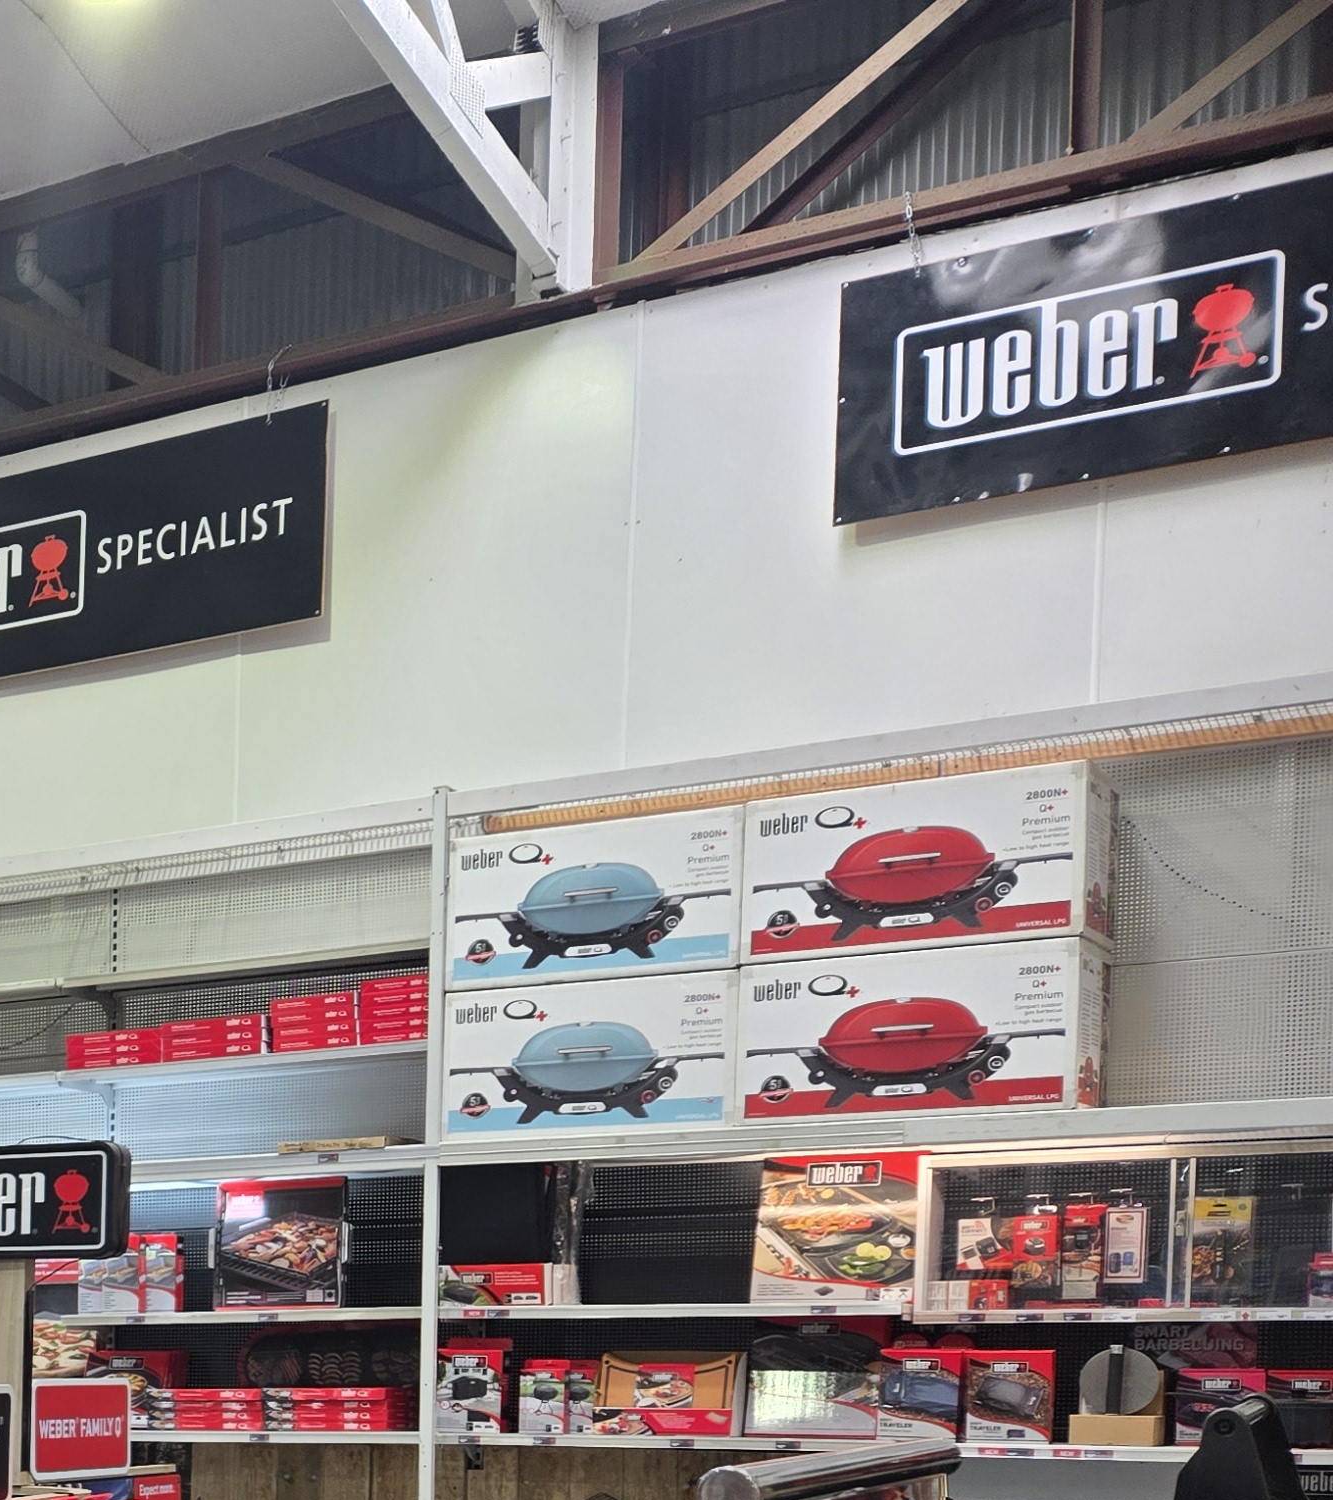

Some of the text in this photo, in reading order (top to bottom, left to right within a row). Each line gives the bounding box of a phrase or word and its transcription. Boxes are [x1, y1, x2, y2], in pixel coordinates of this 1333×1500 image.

[923, 298, 1179, 429] weber
[96, 497, 293, 574] SPECIALIST
[760, 812, 808, 837] weber
[1022, 813, 1071, 826] Premium
[461, 848, 503, 872] weber
[687, 853, 730, 865] Premium
[753, 978, 802, 1002] weber
[1014, 990, 1064, 1002] Premium
[455, 1002, 498, 1025] weber
[680, 1017, 723, 1028] Premium
[812, 1163, 862, 1185] weber
[1134, 1325, 1191, 1339] SMART
[1134, 1338, 1245, 1351] BARBECUING
[1204, 1379, 1231, 1390] weber
[38, 1418, 76, 1439] WEBER
[79, 1416, 113, 1437] FAMILY
[139, 1483, 160, 1499] Expect
